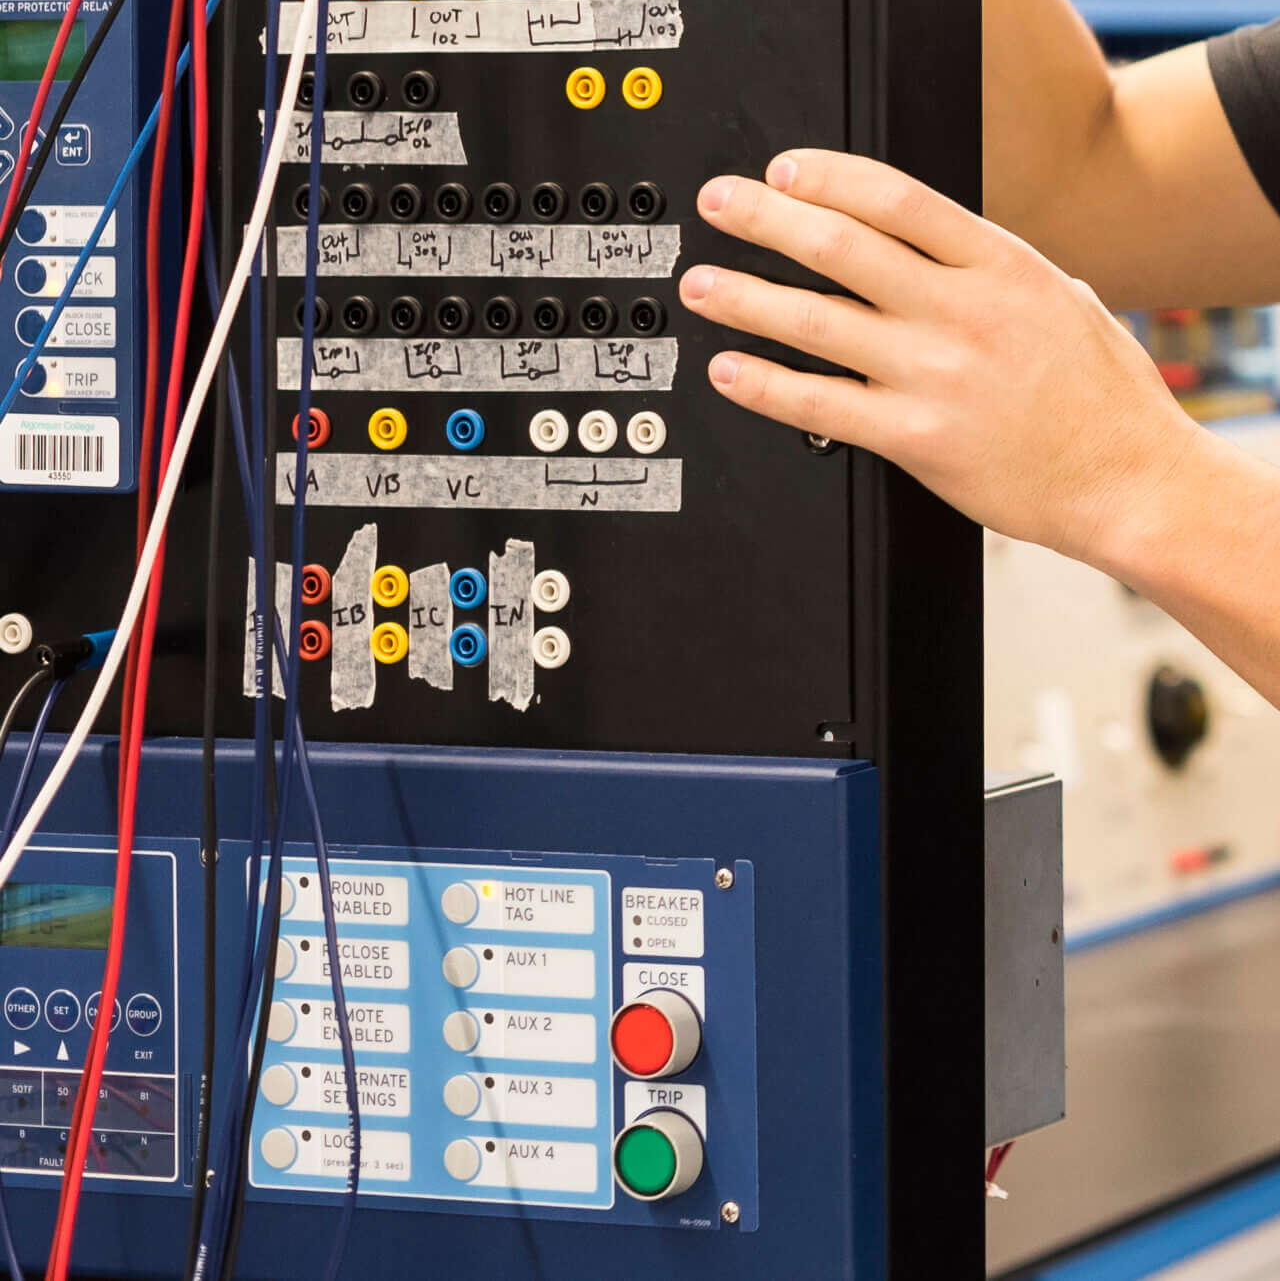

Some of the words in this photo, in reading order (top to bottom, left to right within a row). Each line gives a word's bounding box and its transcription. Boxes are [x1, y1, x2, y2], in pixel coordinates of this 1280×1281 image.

[18, 1, 73, 13] PROTECTIO
[82, 1, 113, 12] RELA
[429, 8, 463, 25] OUT
[327, 31, 343, 44] 01
[432, 31, 460, 45] 102
[649, 23, 677, 37] 103
[62, 146, 83, 158] ENT
[322, 250, 343, 265] 301
[508, 246, 535, 260] 303
[604, 243, 634, 260] 304
[65, 322, 112, 336] CLOSE
[618, 356, 628, 368] 4
[65, 373, 99, 387] TRIP
[366, 473, 401, 498] VB
[446, 475, 481, 501] VC
[580, 490, 599, 507] N
[333, 603, 367, 627] IB
[411, 606, 444, 629] IC
[490, 598, 525, 627] IN
[331, 880, 385, 897] ROUND
[504, 887, 535, 903] HOT
[540, 889, 575, 904] LINE
[332, 900, 392, 917] NABLED
[625, 894, 700, 912] BREAKER
[505, 906, 534, 922] TAG
[646, 915, 688, 928] CLOSED
[646, 938, 676, 949] OPEN
[322, 943, 390, 961] RCLOSE
[506, 952, 537, 967] AUX
[542, 953, 548, 967] 1
[322, 963, 393, 980] EABLED
[638, 970, 689, 987] CLOSE
[7, 1004, 36, 1014] OTHER
[53, 1006, 70, 1016] SET
[128, 1009, 158, 1020] GROUP
[507, 1015, 538, 1031] AUX
[543, 1017, 552, 1031] 2
[323, 1026, 394, 1043] ENBLED
[134, 1050, 153, 1060] EXIT
[323, 1070, 408, 1089] ALRNATE
[507, 1079, 539, 1095] AUX
[544, 1081, 553, 1095] 3
[57, 1087, 69, 1097] 50
[647, 1089, 684, 1106] TRIP
[508, 1144, 540, 1159] AUX
[545, 1146, 555, 1159] 4
[39, 1157, 64, 1167] FAULT
